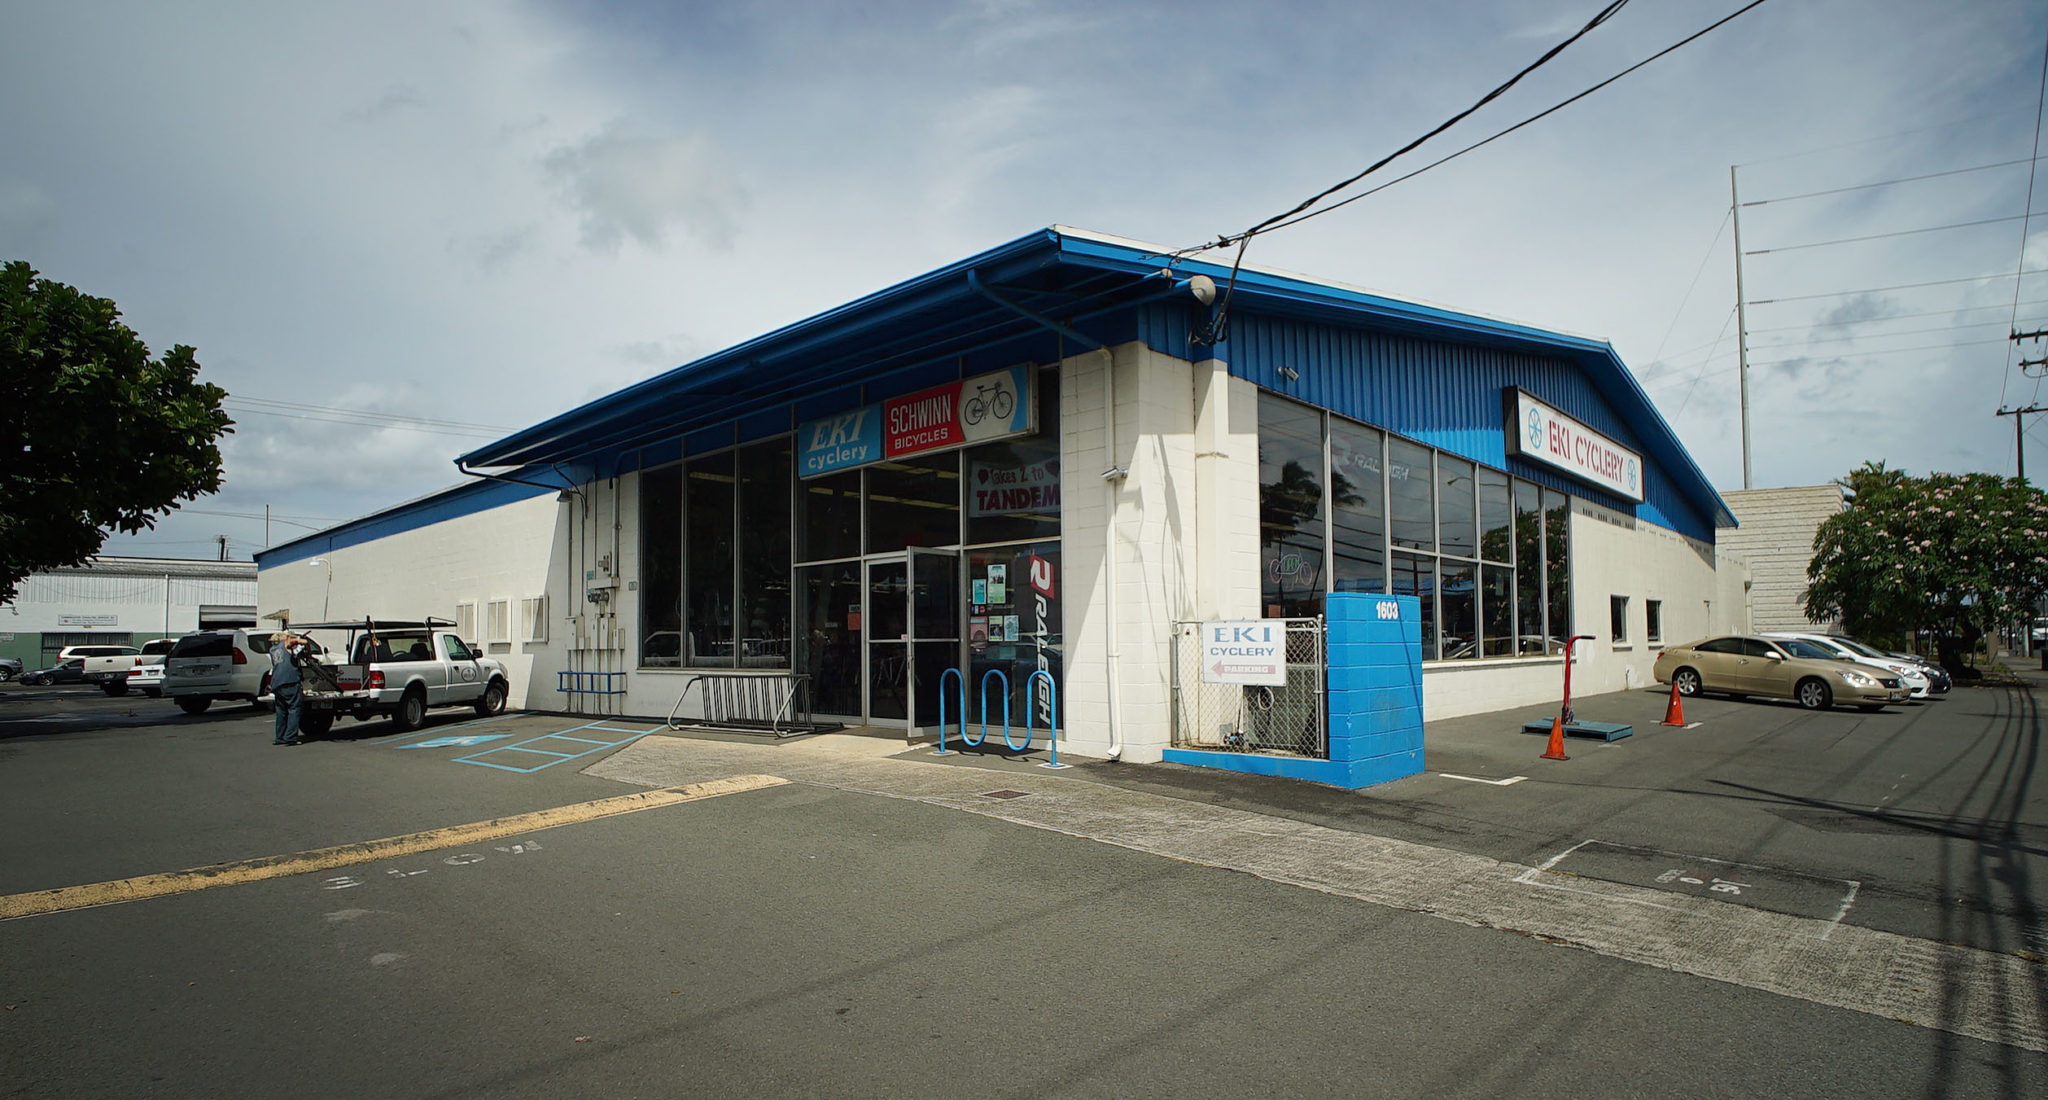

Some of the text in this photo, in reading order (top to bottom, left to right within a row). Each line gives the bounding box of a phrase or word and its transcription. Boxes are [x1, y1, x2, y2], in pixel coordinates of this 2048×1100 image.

[890, 394, 951, 435] SCHWINN
[808, 409, 870, 450] EKI
[894, 427, 949, 450] BICYCLES
[808, 443, 868, 470] cyclery
[1548, 419, 1624, 483] EKI CYCLERY
[1020, 465, 1028, 483] 2
[976, 483, 1061, 511] TANDEM
[1375, 600, 1399, 620] 1603
[1213, 626, 1271, 643] EKI
[1035, 592, 1051, 726] RALEIGH
[1209, 646, 1275, 657] CYCLERY
[1223, 664, 1269, 674] PARKING
